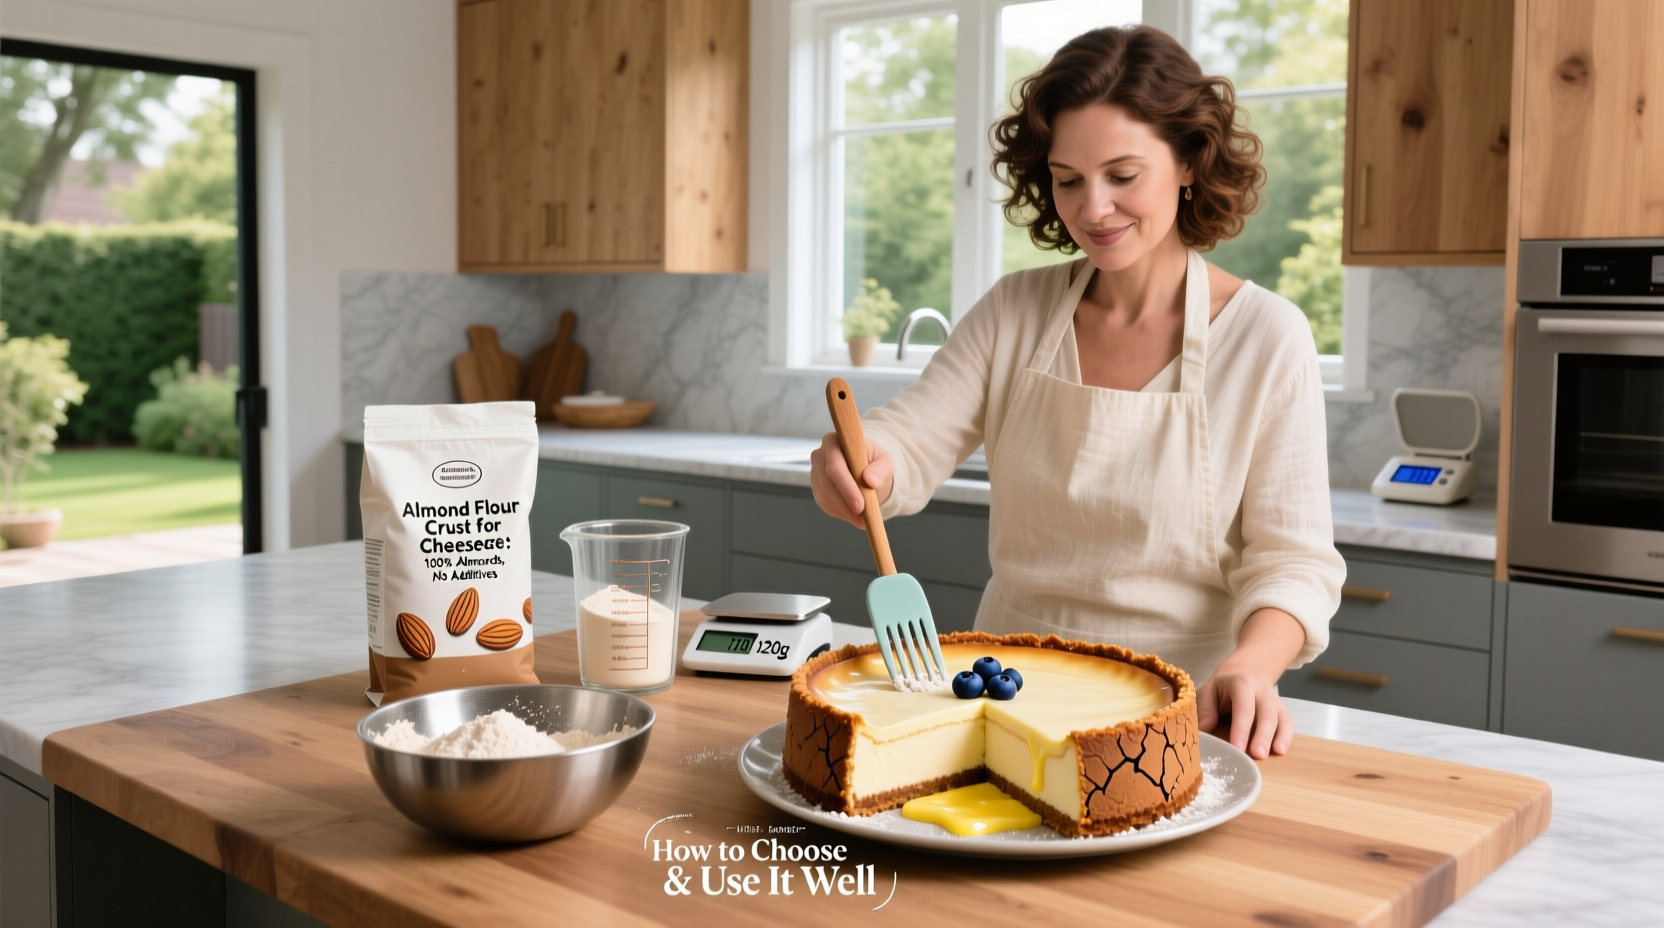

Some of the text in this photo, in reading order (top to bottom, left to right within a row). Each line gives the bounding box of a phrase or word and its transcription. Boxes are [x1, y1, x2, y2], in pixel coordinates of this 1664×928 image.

[402, 498, 520, 518] Almond Flour
[424, 517, 502, 536] Crust for
[424, 557, 453, 569] 100%
[432, 571, 448, 582] No
[756, 640, 790, 660] 120g
